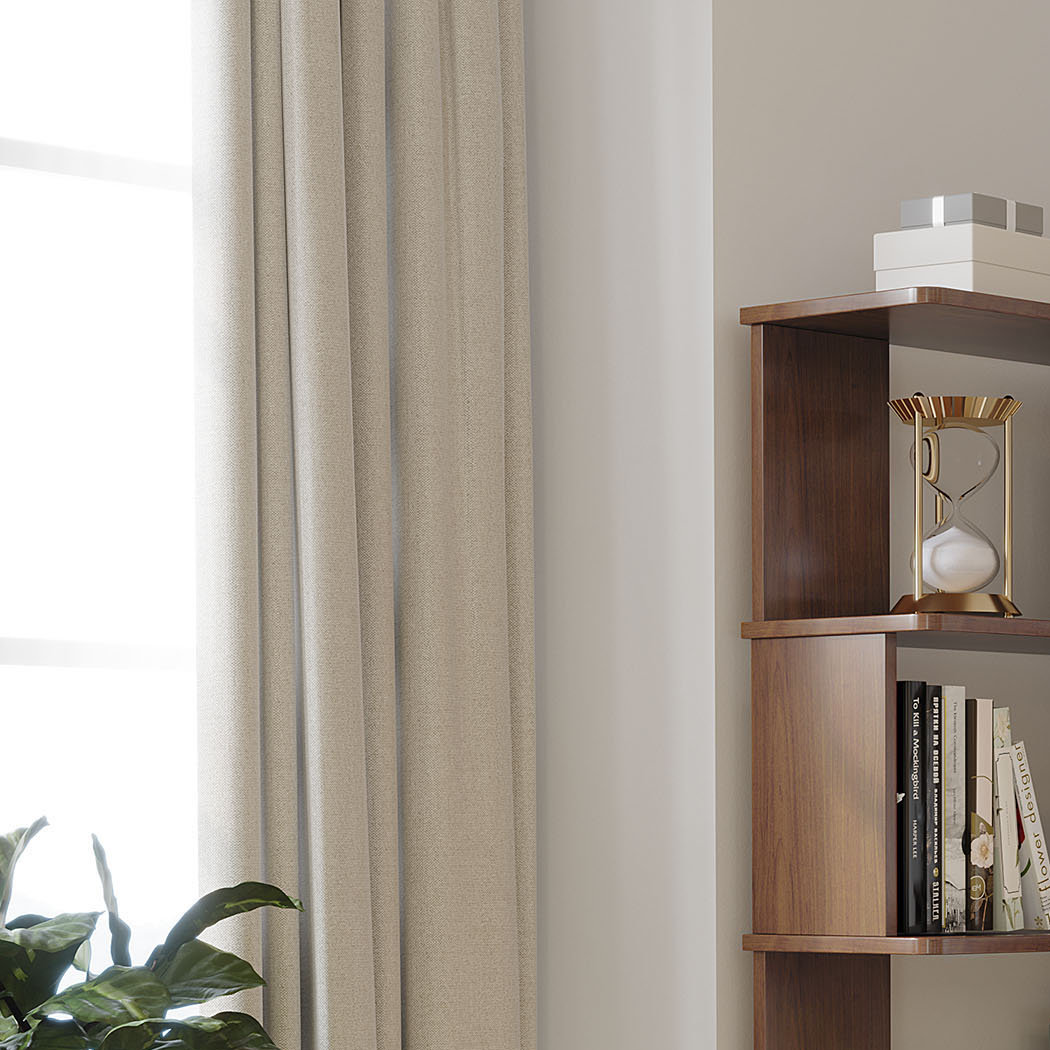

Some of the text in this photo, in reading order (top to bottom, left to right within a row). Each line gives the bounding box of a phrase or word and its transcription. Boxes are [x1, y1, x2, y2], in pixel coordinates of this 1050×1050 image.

[912, 697, 920, 710] To
[912, 712, 920, 728] Kill
[910, 739, 920, 800] Mockingbird
[1015, 744, 1036, 824] designer
[1032, 832, 1050, 892] flower
